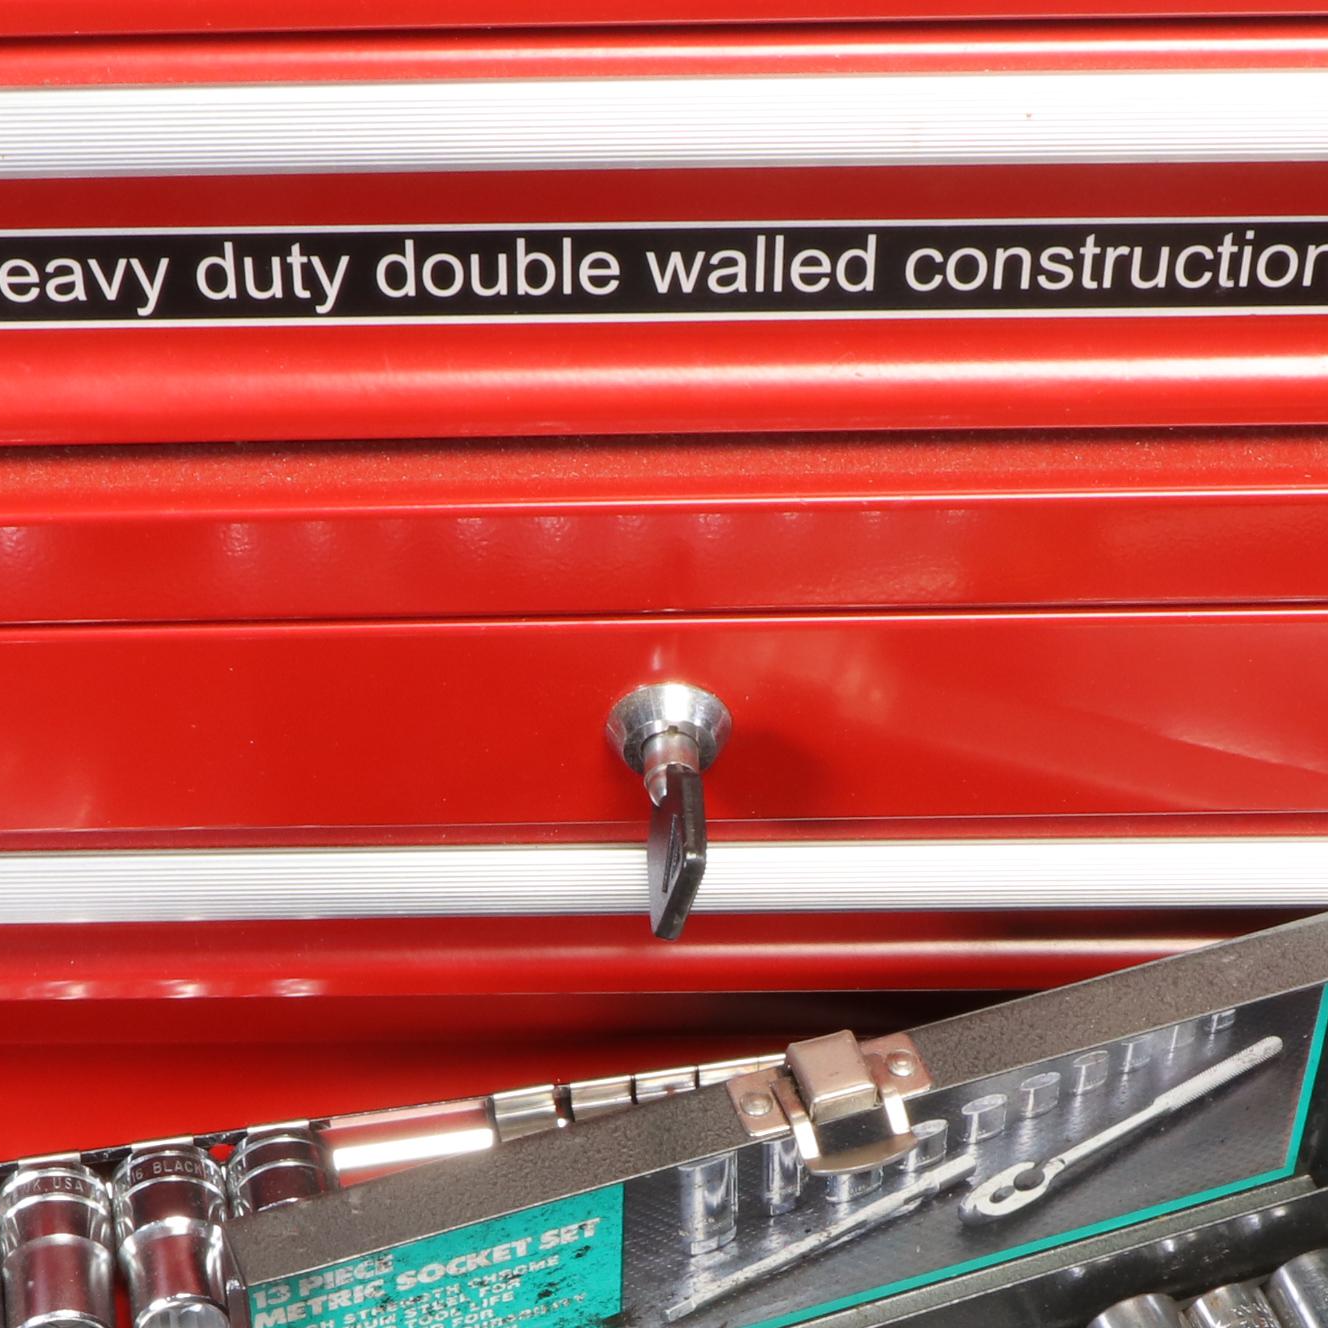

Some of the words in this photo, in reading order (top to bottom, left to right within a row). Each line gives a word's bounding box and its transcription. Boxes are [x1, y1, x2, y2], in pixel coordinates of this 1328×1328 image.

[197, 242, 350, 313] duty
[377, 238, 620, 298] double
[646, 234, 877, 294] walled
[396, 1237, 532, 1291] SOCKET
[539, 1217, 601, 1250] SET
[252, 1283, 291, 1309] 13
[299, 1254, 394, 1297] PIECE
[479, 1278, 521, 1298] FOR
[406, 1307, 462, 1328] TOOL
[469, 1291, 515, 1312] LIFE
[452, 1308, 494, 1328] FOR
